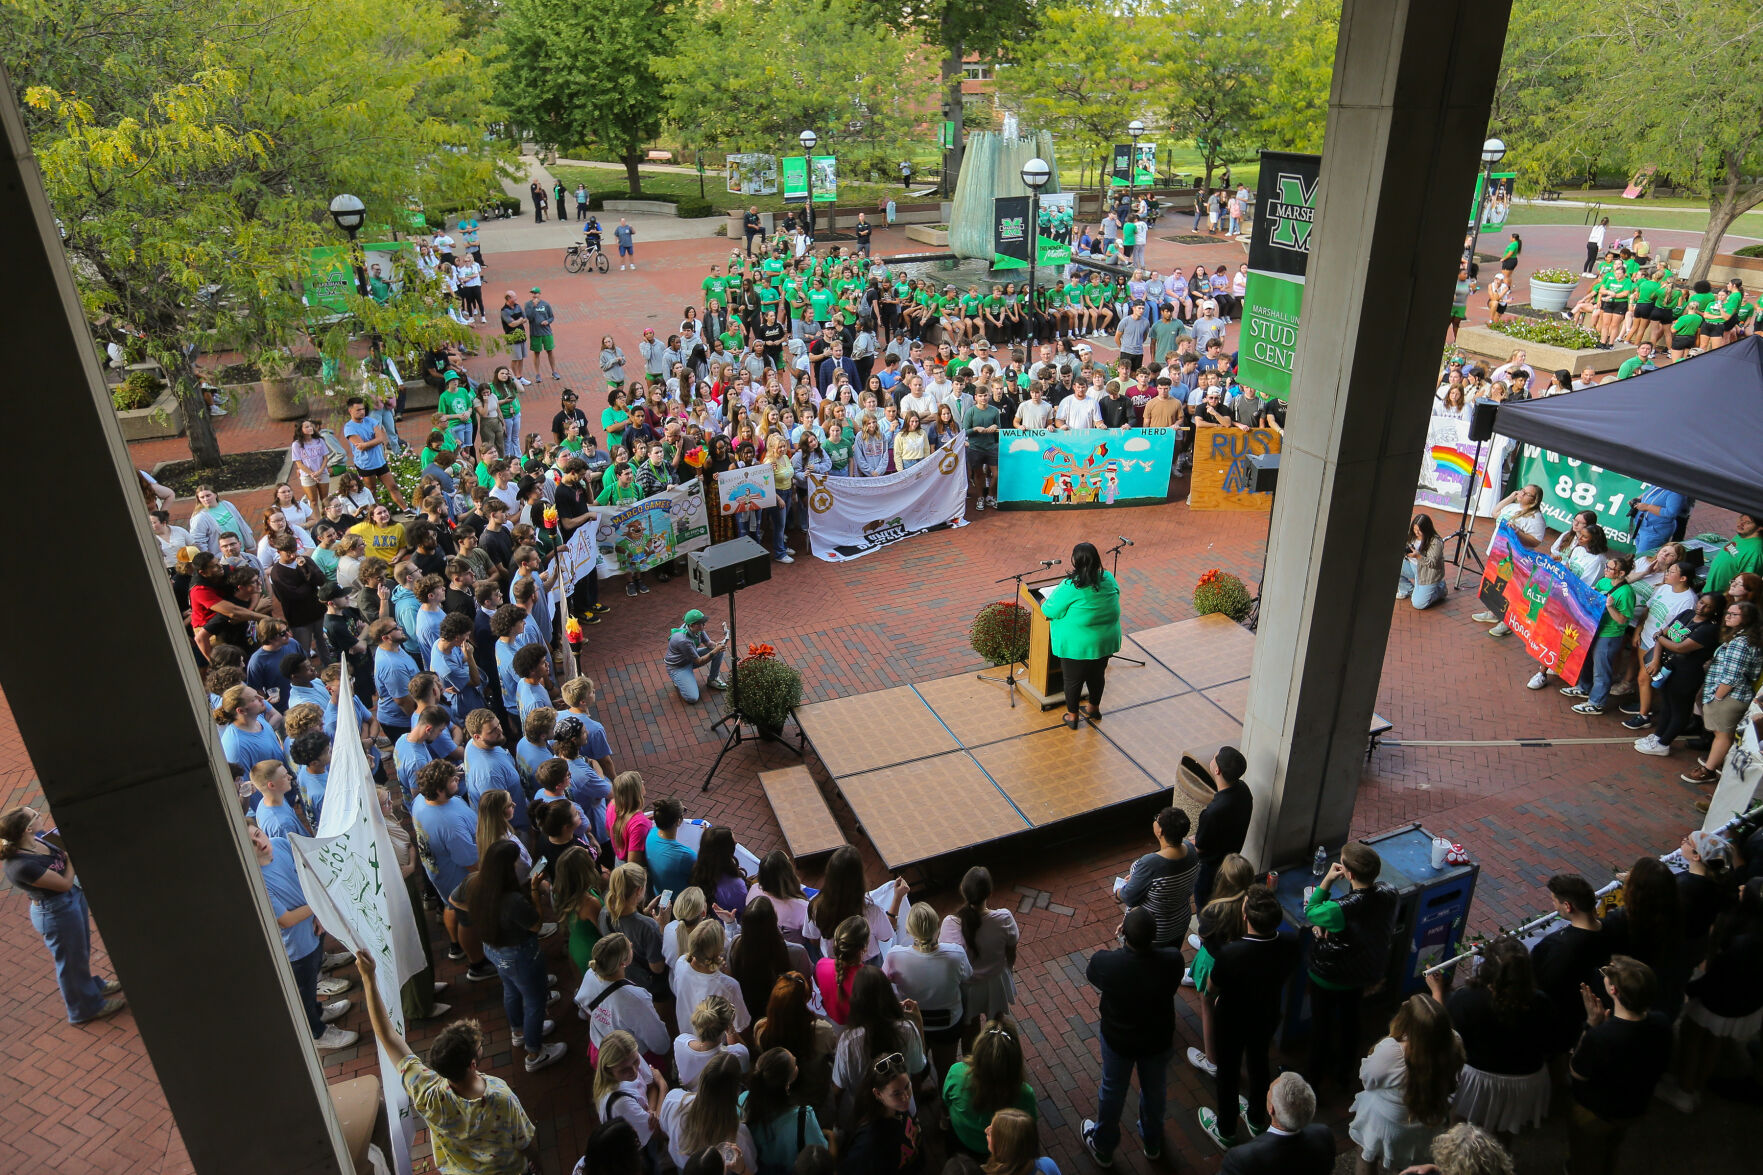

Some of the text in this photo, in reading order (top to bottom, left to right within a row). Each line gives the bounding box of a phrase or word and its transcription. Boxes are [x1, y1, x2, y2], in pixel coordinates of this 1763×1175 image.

[1276, 203, 1315, 222] MARSH
[1253, 305, 1288, 321] MARSHALL
[1250, 318, 1296, 347] STUD
[1254, 342, 1296, 370] CENT
[1002, 429, 1046, 437] WALKING
[1141, 428, 1167, 436] HERD
[1211, 430, 1272, 458] RUS
[1555, 475, 1625, 516] 88.1
[612, 500, 671, 525] MARCO GAMES
[1539, 501, 1573, 525] SHALL
[867, 525, 905, 541] UNITY
[1539, 643, 1557, 665] 75
